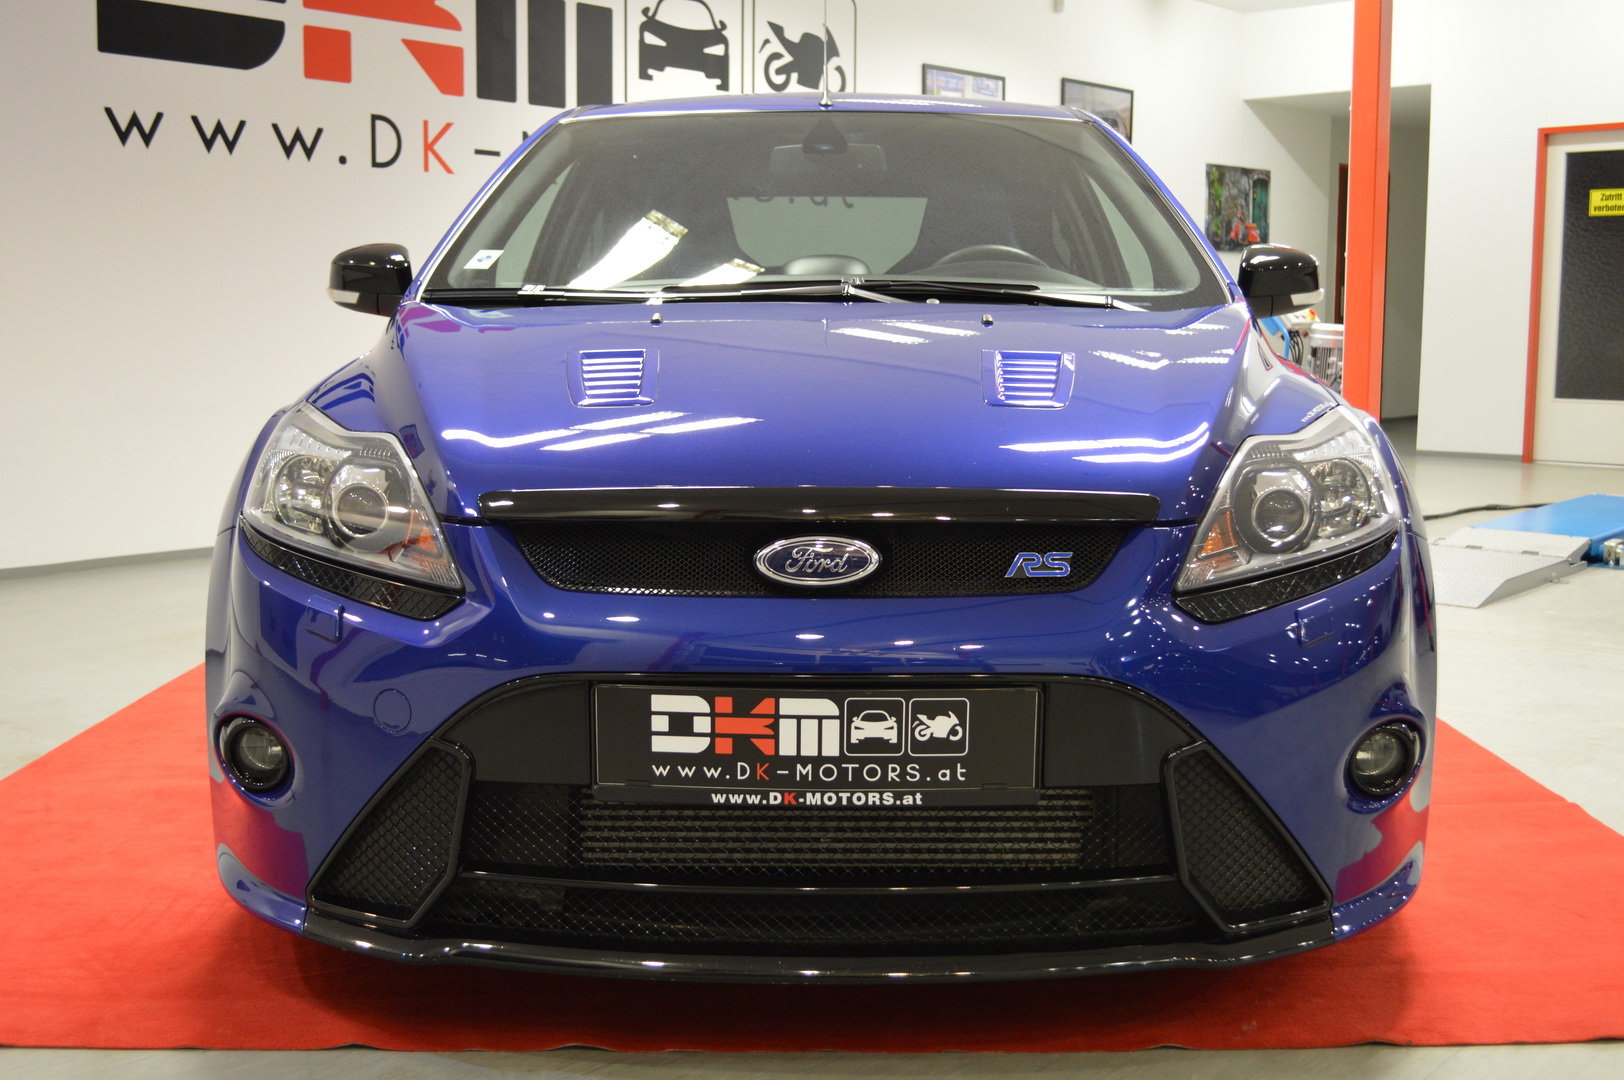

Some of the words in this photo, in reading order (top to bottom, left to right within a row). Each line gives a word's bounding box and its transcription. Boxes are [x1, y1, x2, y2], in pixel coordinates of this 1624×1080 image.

[104, 106, 529, 174] www.DK-
[1600, 193, 1623, 202] Zutritt
[784, 546, 850, 573] Ford
[1004, 551, 1074, 578] RS
[650, 693, 840, 757] DKM
[651, 761, 967, 782] www.DK-MOTORS.at
[711, 791, 923, 806] www.DK-MOTORS.at
